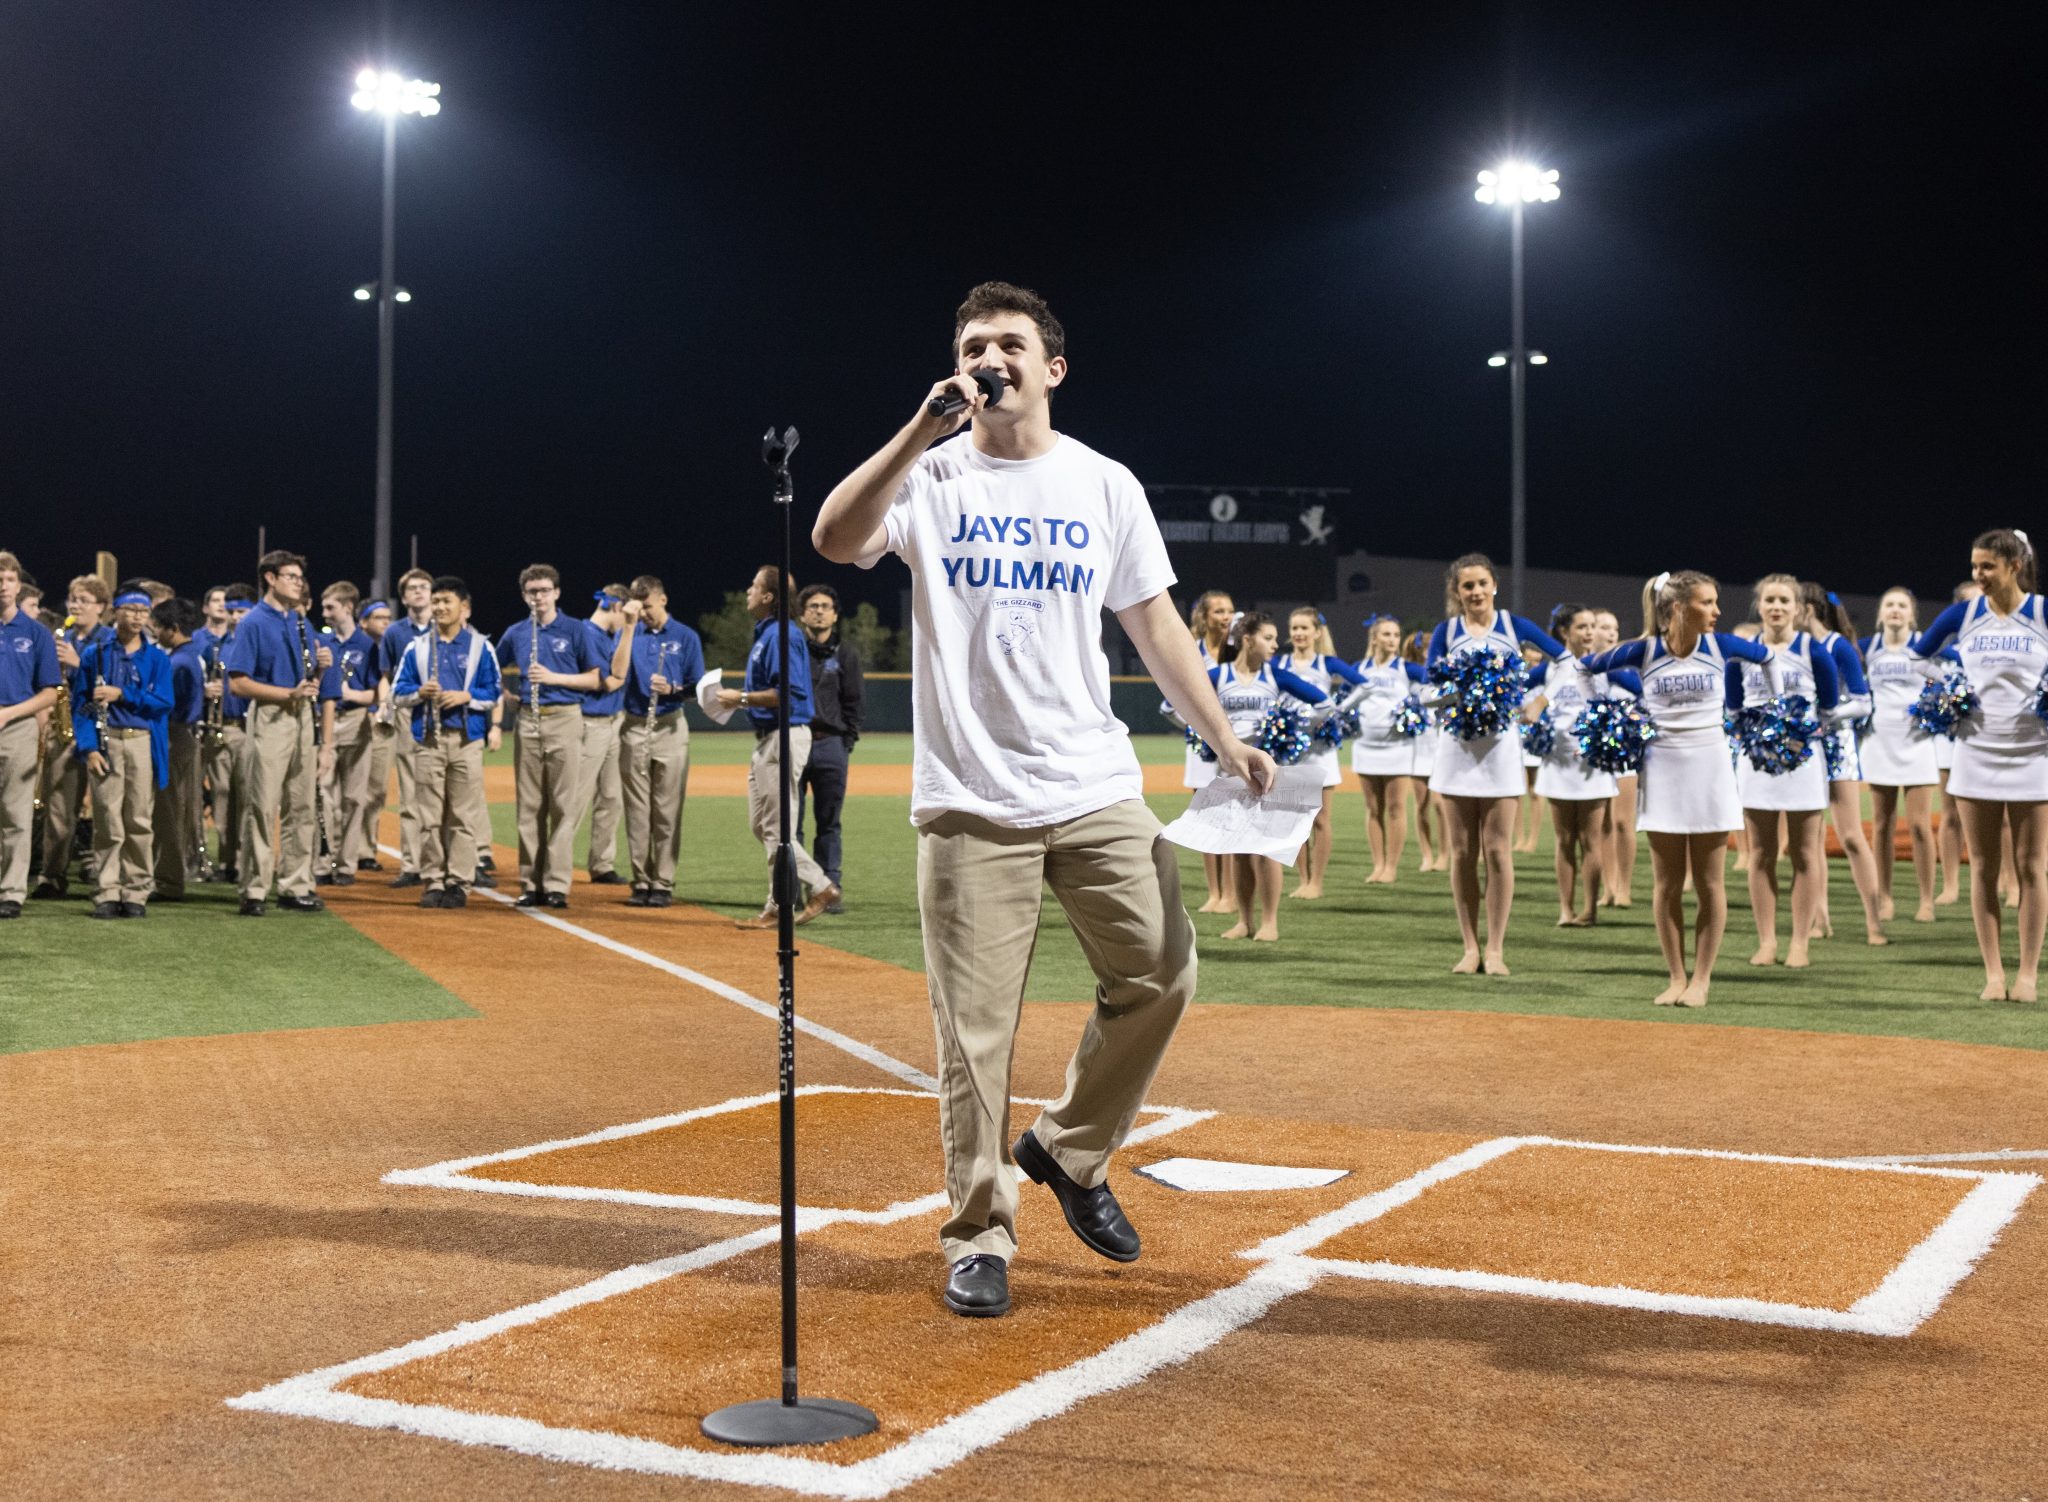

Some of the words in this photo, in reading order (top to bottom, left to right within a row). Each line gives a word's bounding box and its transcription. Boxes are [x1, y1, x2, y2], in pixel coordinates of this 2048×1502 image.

[951, 514, 1031, 546] JAYS
[1043, 518, 1089, 549] TO
[941, 557, 1094, 596] YULMAN
[1010, 599, 1042, 609] GIZZARD
[1968, 636, 2033, 654] JESUIT
[1652, 674, 1715, 696] JESUIT
